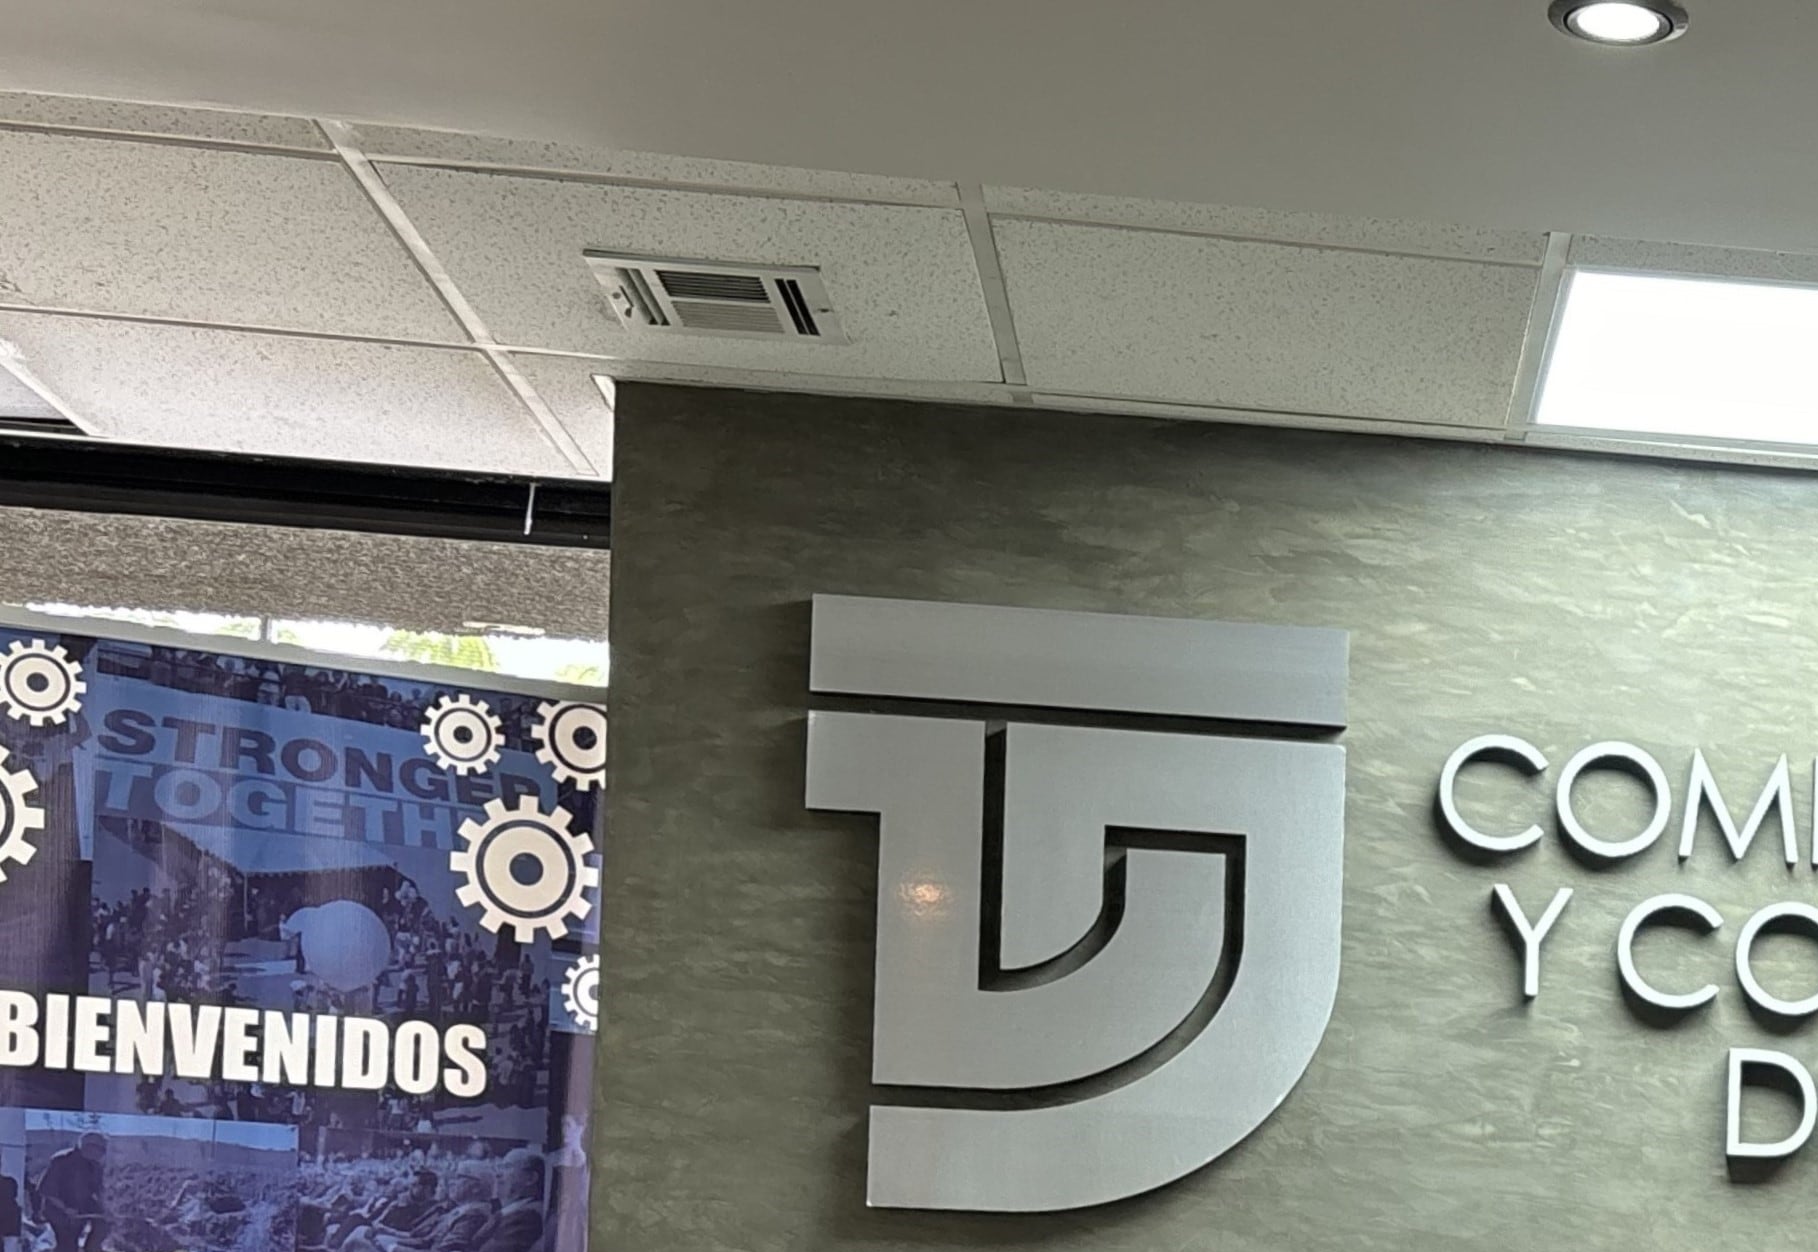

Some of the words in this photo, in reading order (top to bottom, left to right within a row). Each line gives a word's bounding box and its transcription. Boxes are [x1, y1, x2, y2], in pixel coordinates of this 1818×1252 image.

[96, 760, 475, 852] TOGETH
[1493, 883, 1574, 998] Y
[0, 990, 487, 1098] BIENVENIDOS
